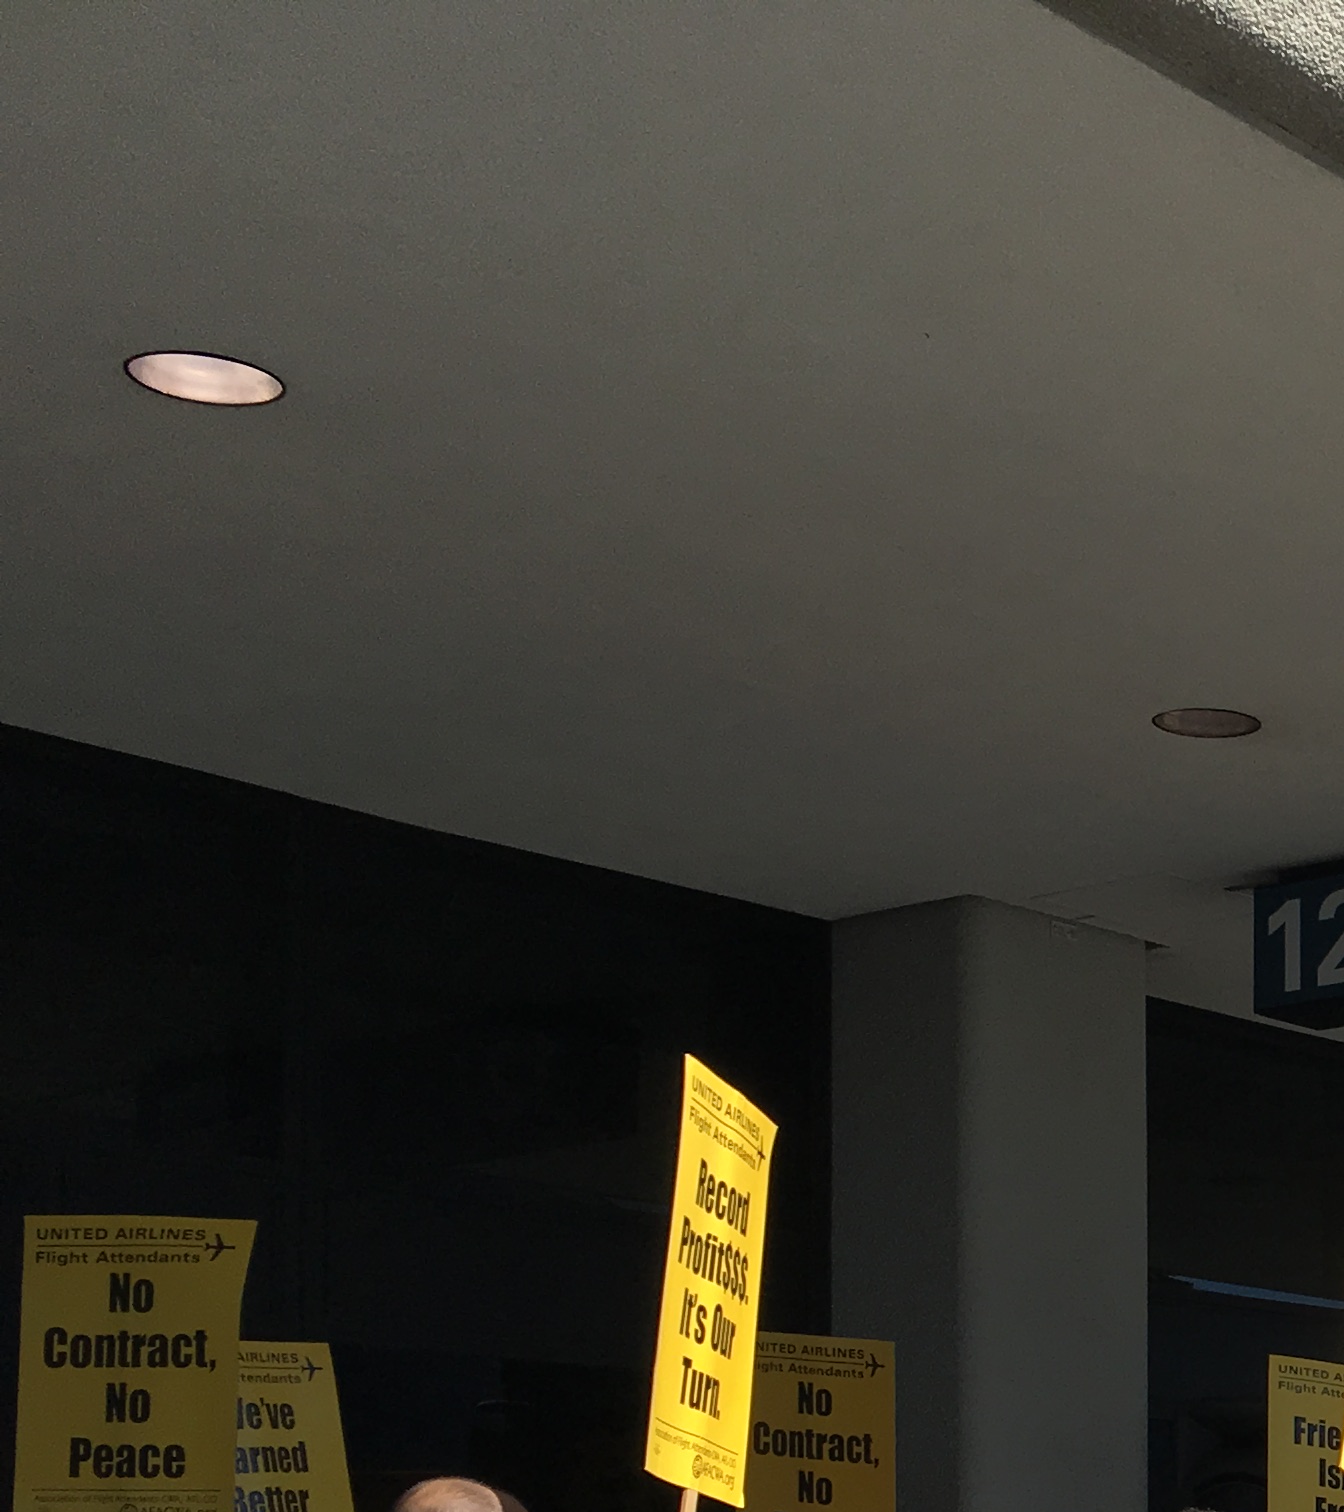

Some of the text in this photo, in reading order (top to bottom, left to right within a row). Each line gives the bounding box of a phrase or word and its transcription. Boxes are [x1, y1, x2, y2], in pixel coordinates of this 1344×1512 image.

[691, 1075, 760, 1142] UNITED AIRLINES
[689, 1106, 757, 1170] Flight Attendants
[695, 1157, 751, 1237] Record
[36, 1227, 206, 1241] UNITED AIRLINES
[35, 1251, 200, 1267] Flight Attendants
[677, 1215, 749, 1305] Profit$$$.
[109, 1272, 154, 1314] No
[679, 1287, 736, 1360] It's Our
[43, 1326, 217, 1373] Contract,
[756, 1341, 865, 1360] NITED AIRLINES
[679, 1355, 720, 1421] Turn.
[757, 1362, 864, 1379] ight Attendants
[1278, 1364, 1329, 1380] UNITED
[1278, 1380, 1316, 1395] Flight
[105, 1383, 151, 1424] No
[797, 1381, 833, 1416] No
[69, 1437, 186, 1479] Peace
[235, 1441, 308, 1473] arned
[753, 1421, 880, 1468] Contract,
[797, 1470, 833, 1505] No
